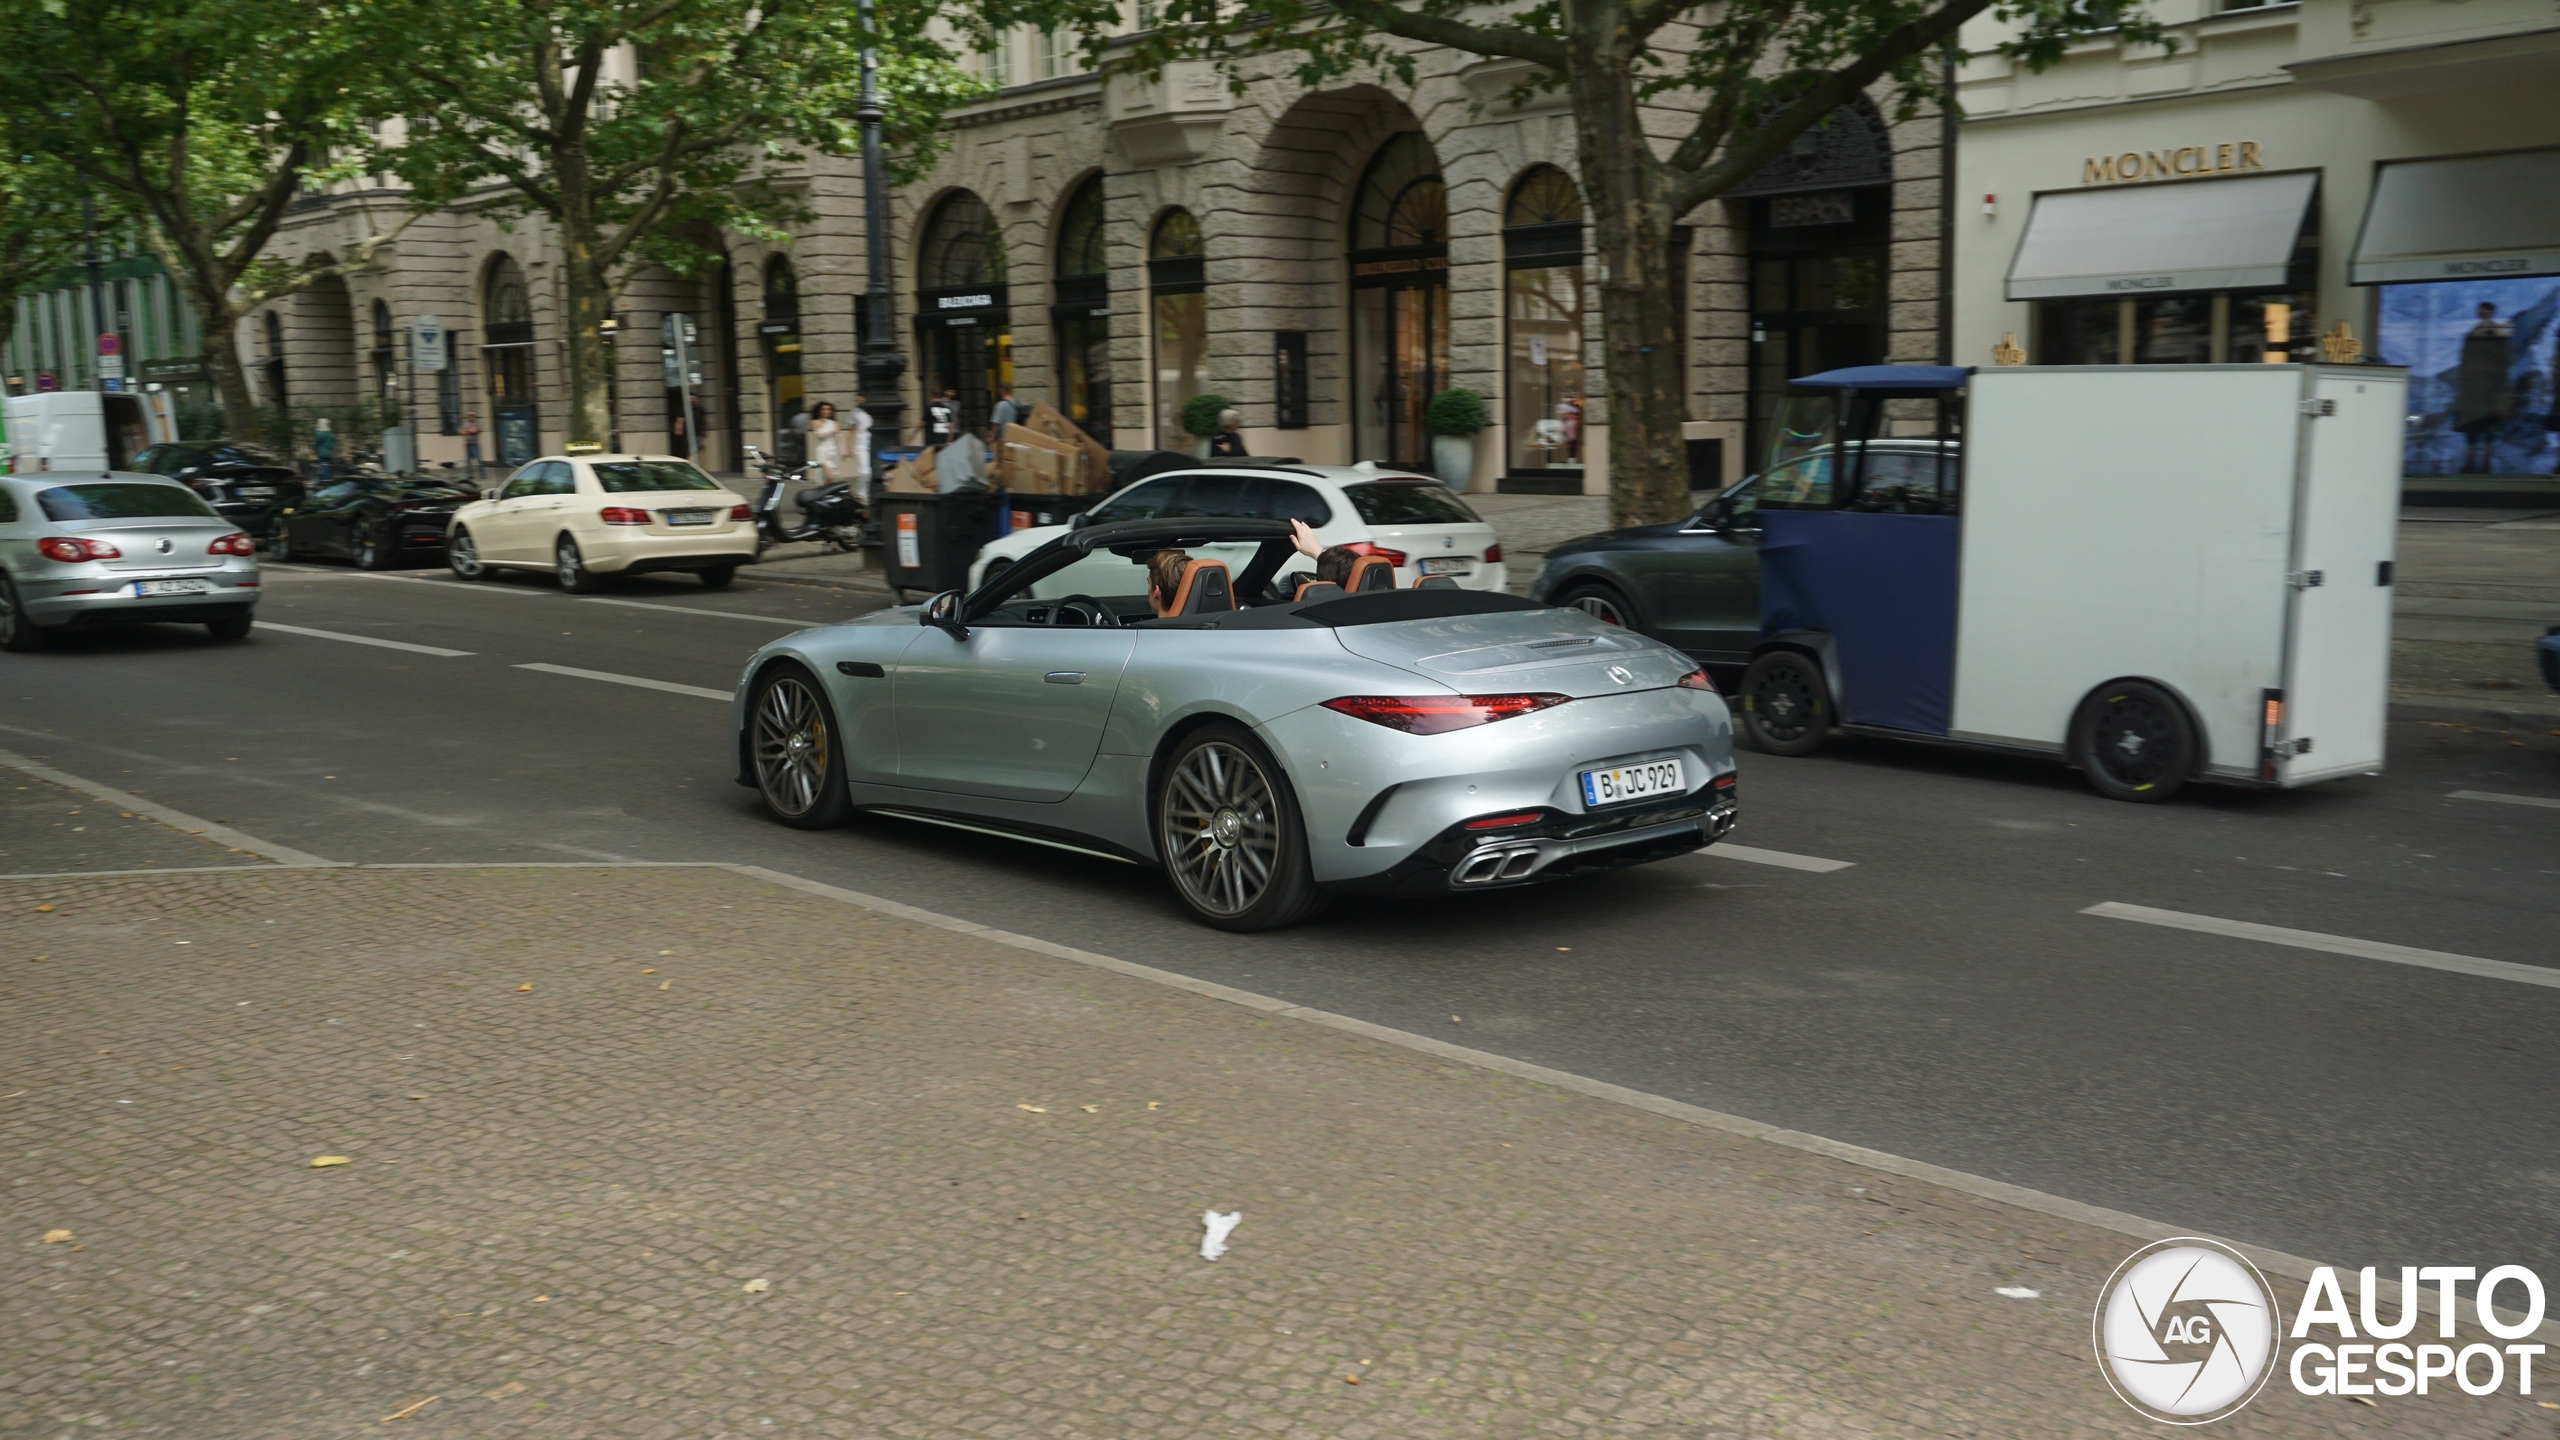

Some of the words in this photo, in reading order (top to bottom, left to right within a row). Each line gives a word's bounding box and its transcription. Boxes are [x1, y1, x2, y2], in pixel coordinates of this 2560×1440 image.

[2082, 140, 2264, 184] MONCLER
[1601, 773, 1614, 798] B
[1625, 768, 1646, 794] JC
[1647, 763, 1676, 790] 929
